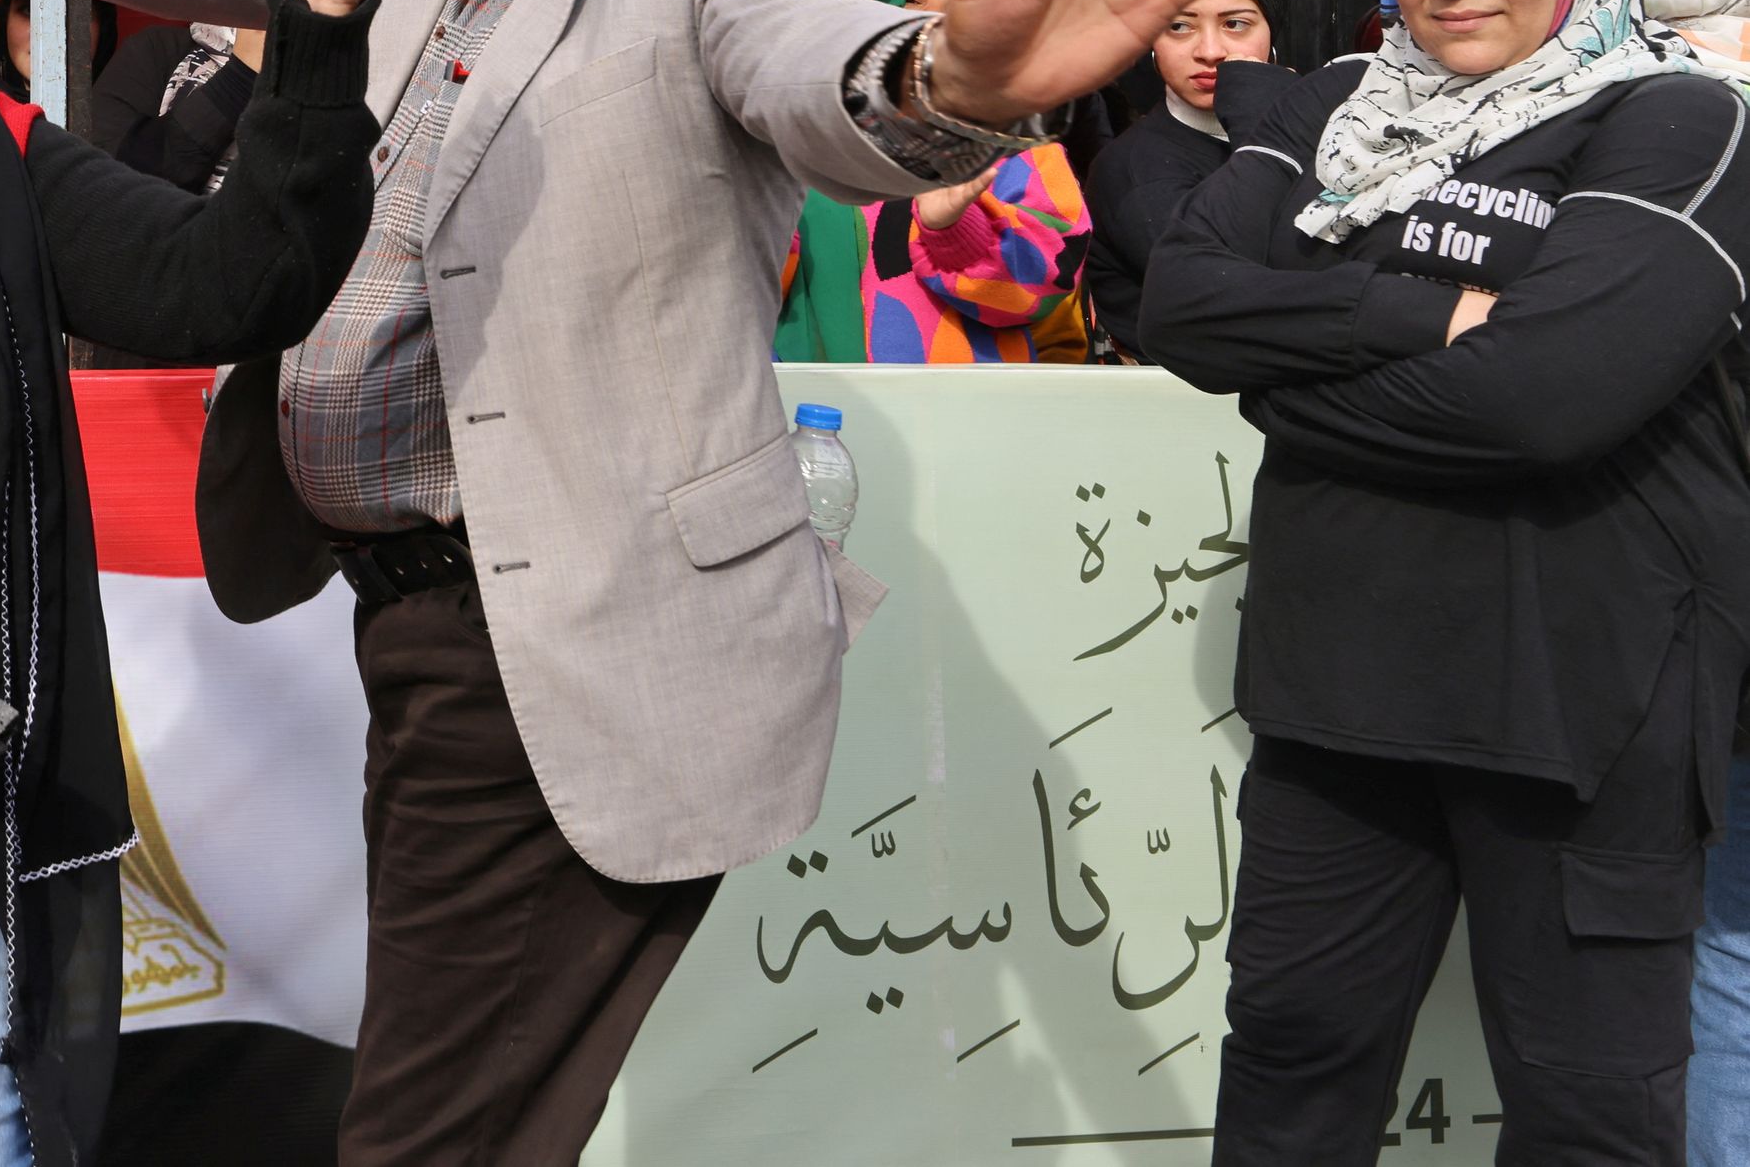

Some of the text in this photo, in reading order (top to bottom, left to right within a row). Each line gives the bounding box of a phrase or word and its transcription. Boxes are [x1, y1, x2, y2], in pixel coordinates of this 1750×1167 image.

[1422, 179, 1557, 230] ecyclin
[1401, 215, 1492, 266] is for
[1072, 450, 1249, 662] لجيزة
